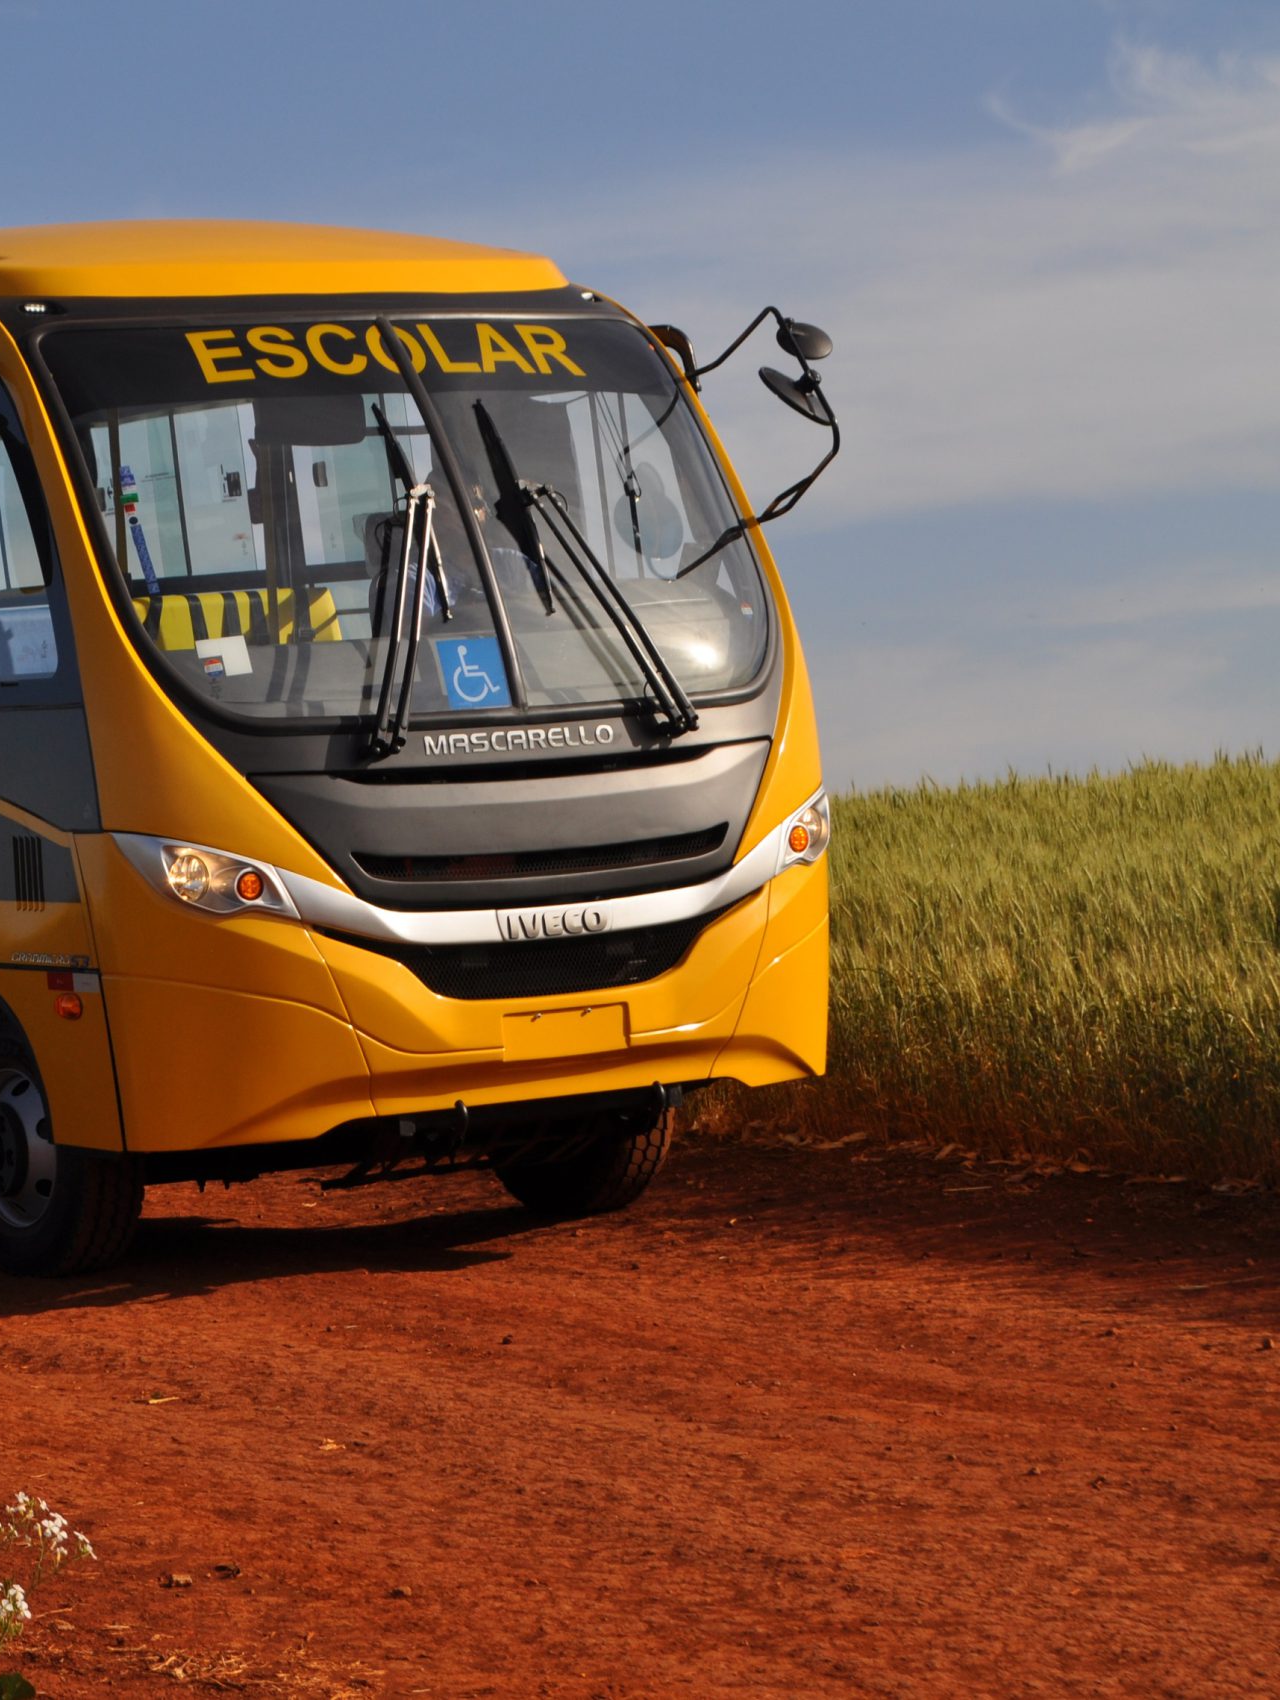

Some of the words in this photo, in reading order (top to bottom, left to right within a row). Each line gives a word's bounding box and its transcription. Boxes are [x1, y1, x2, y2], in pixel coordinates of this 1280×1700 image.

[185, 323, 587, 384] ESCOLAR
[424, 724, 615, 756] MASCARELLO
[506, 908, 608, 940] IVECO
